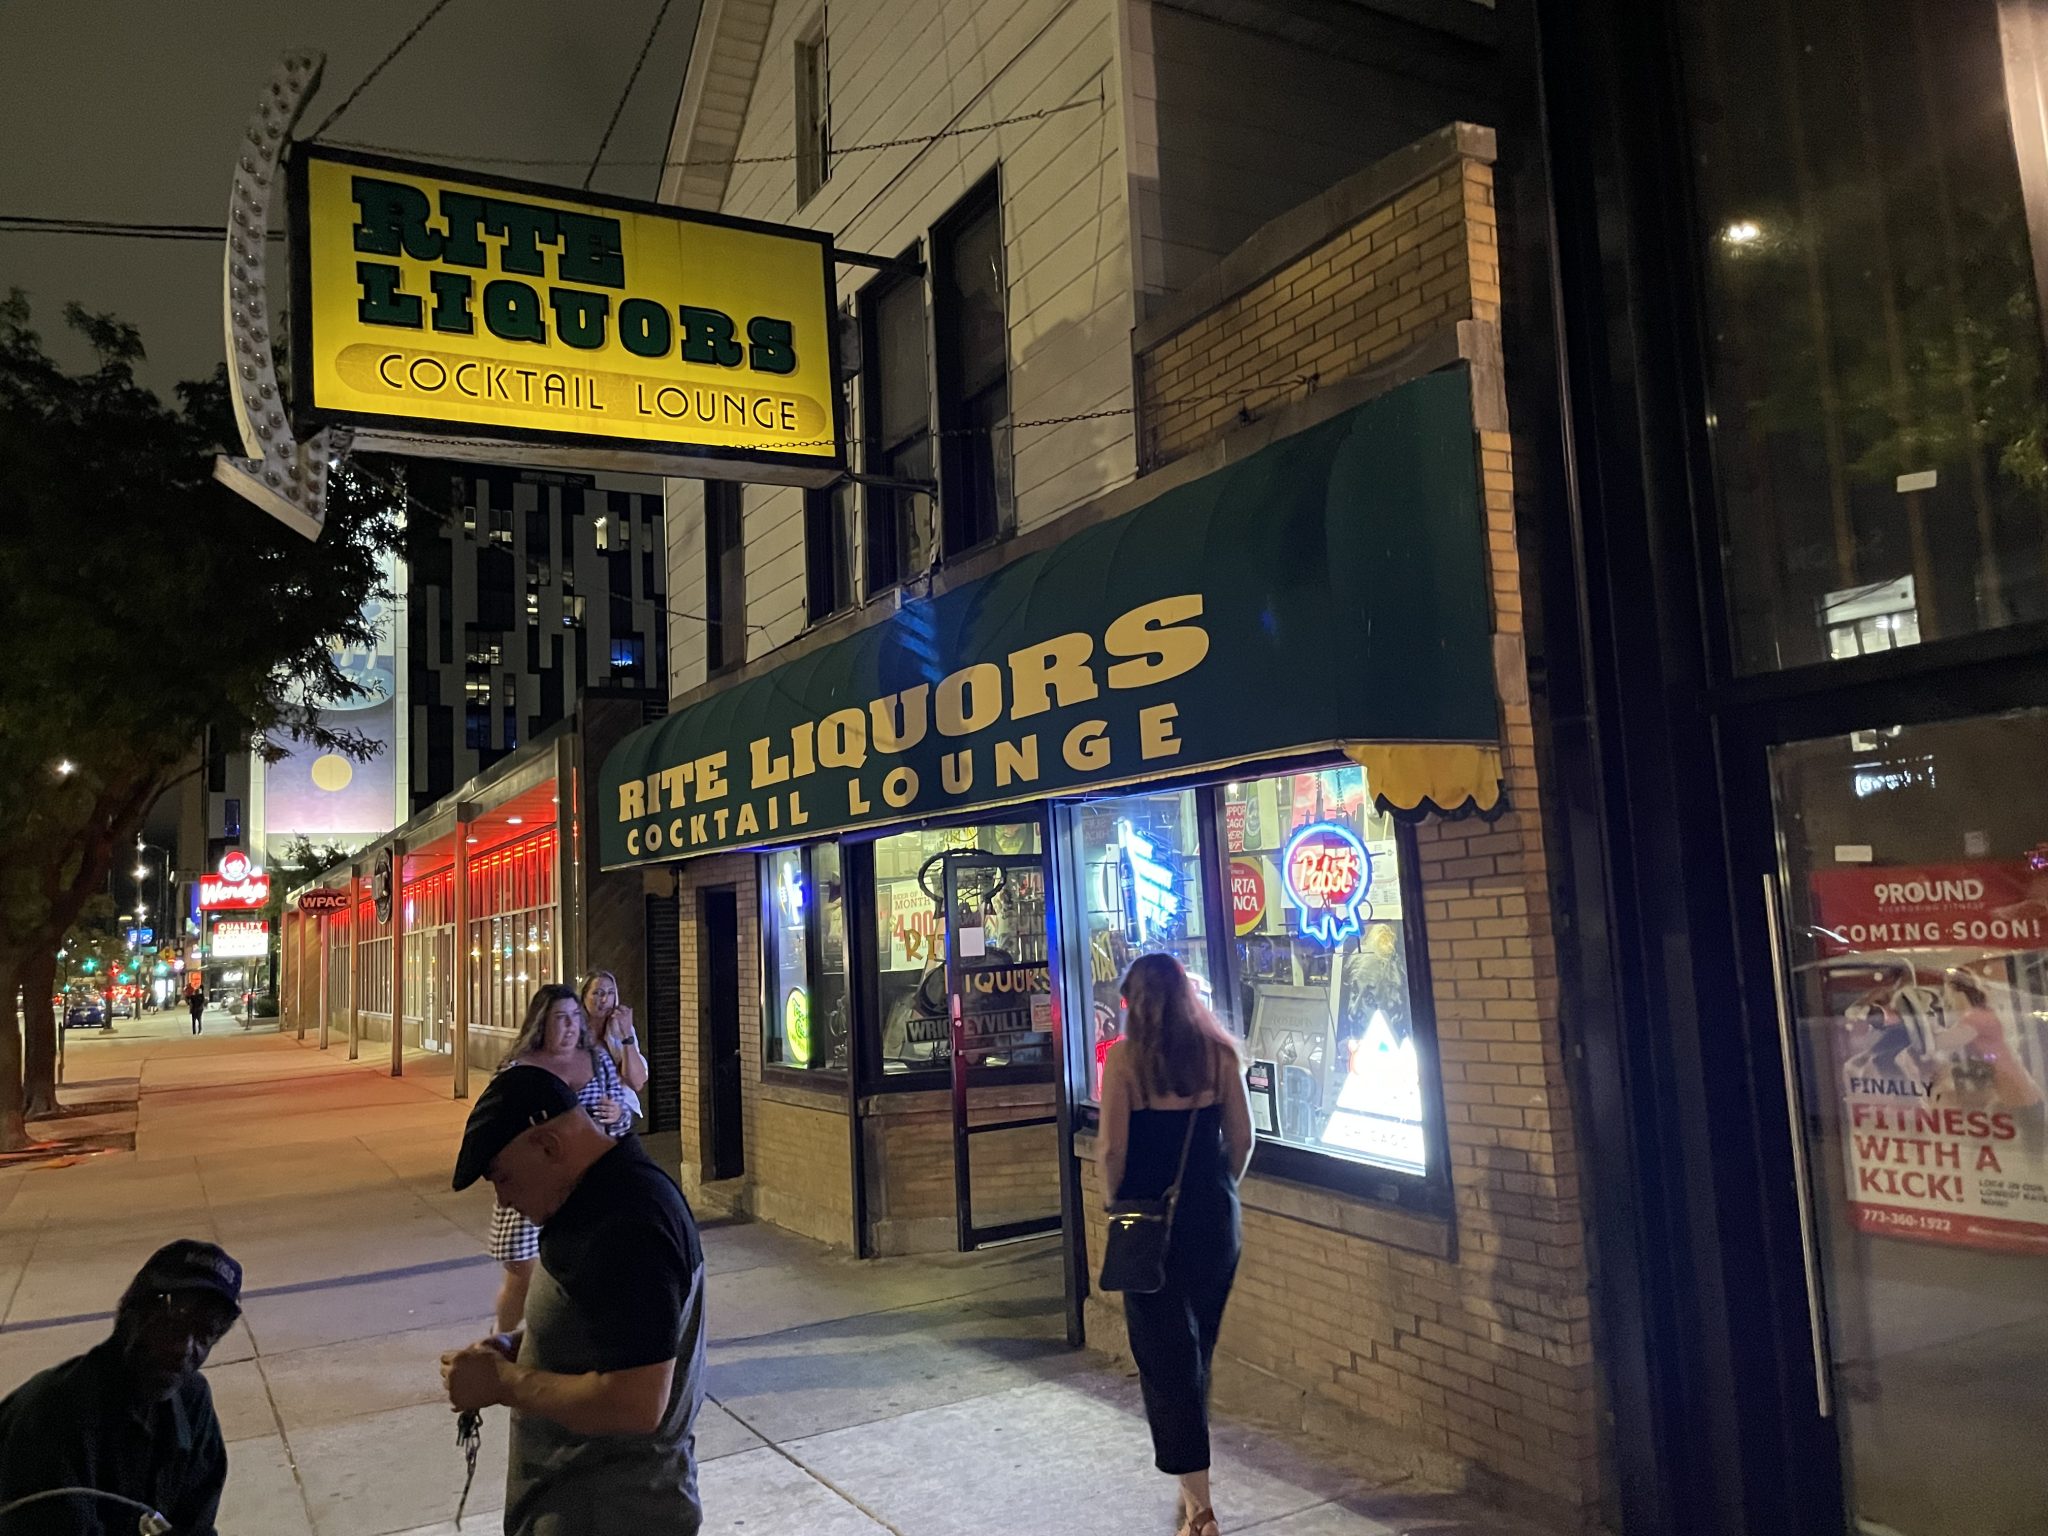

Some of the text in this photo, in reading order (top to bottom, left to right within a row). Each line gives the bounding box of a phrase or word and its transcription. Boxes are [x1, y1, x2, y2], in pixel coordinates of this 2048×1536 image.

[352, 177, 625, 289] RITE
[357, 260, 797, 375] LIQUORS
[379, 354, 797, 432] COCKTAIL LOUNGE
[619, 593, 1210, 823] RITE LIQUORS
[626, 702, 1183, 856] COCKTAIL LOUNGE
[1231, 878, 1257, 895] ARTA
[1299, 850, 1355, 894] Pabst
[303, 896, 347, 908] WPAC
[895, 897, 931, 910] MONTH
[1874, 879, 1985, 904] 9ROUND
[218, 922, 262, 931] QUALITY
[1834, 919, 2041, 944] COMING SOON!
[1850, 1077, 1942, 1101] FINALLY,
[1851, 1104, 2017, 1141] FITNESS
[1854, 1135, 2003, 1174] WITH A
[1859, 1166, 1965, 1204] KICK!
